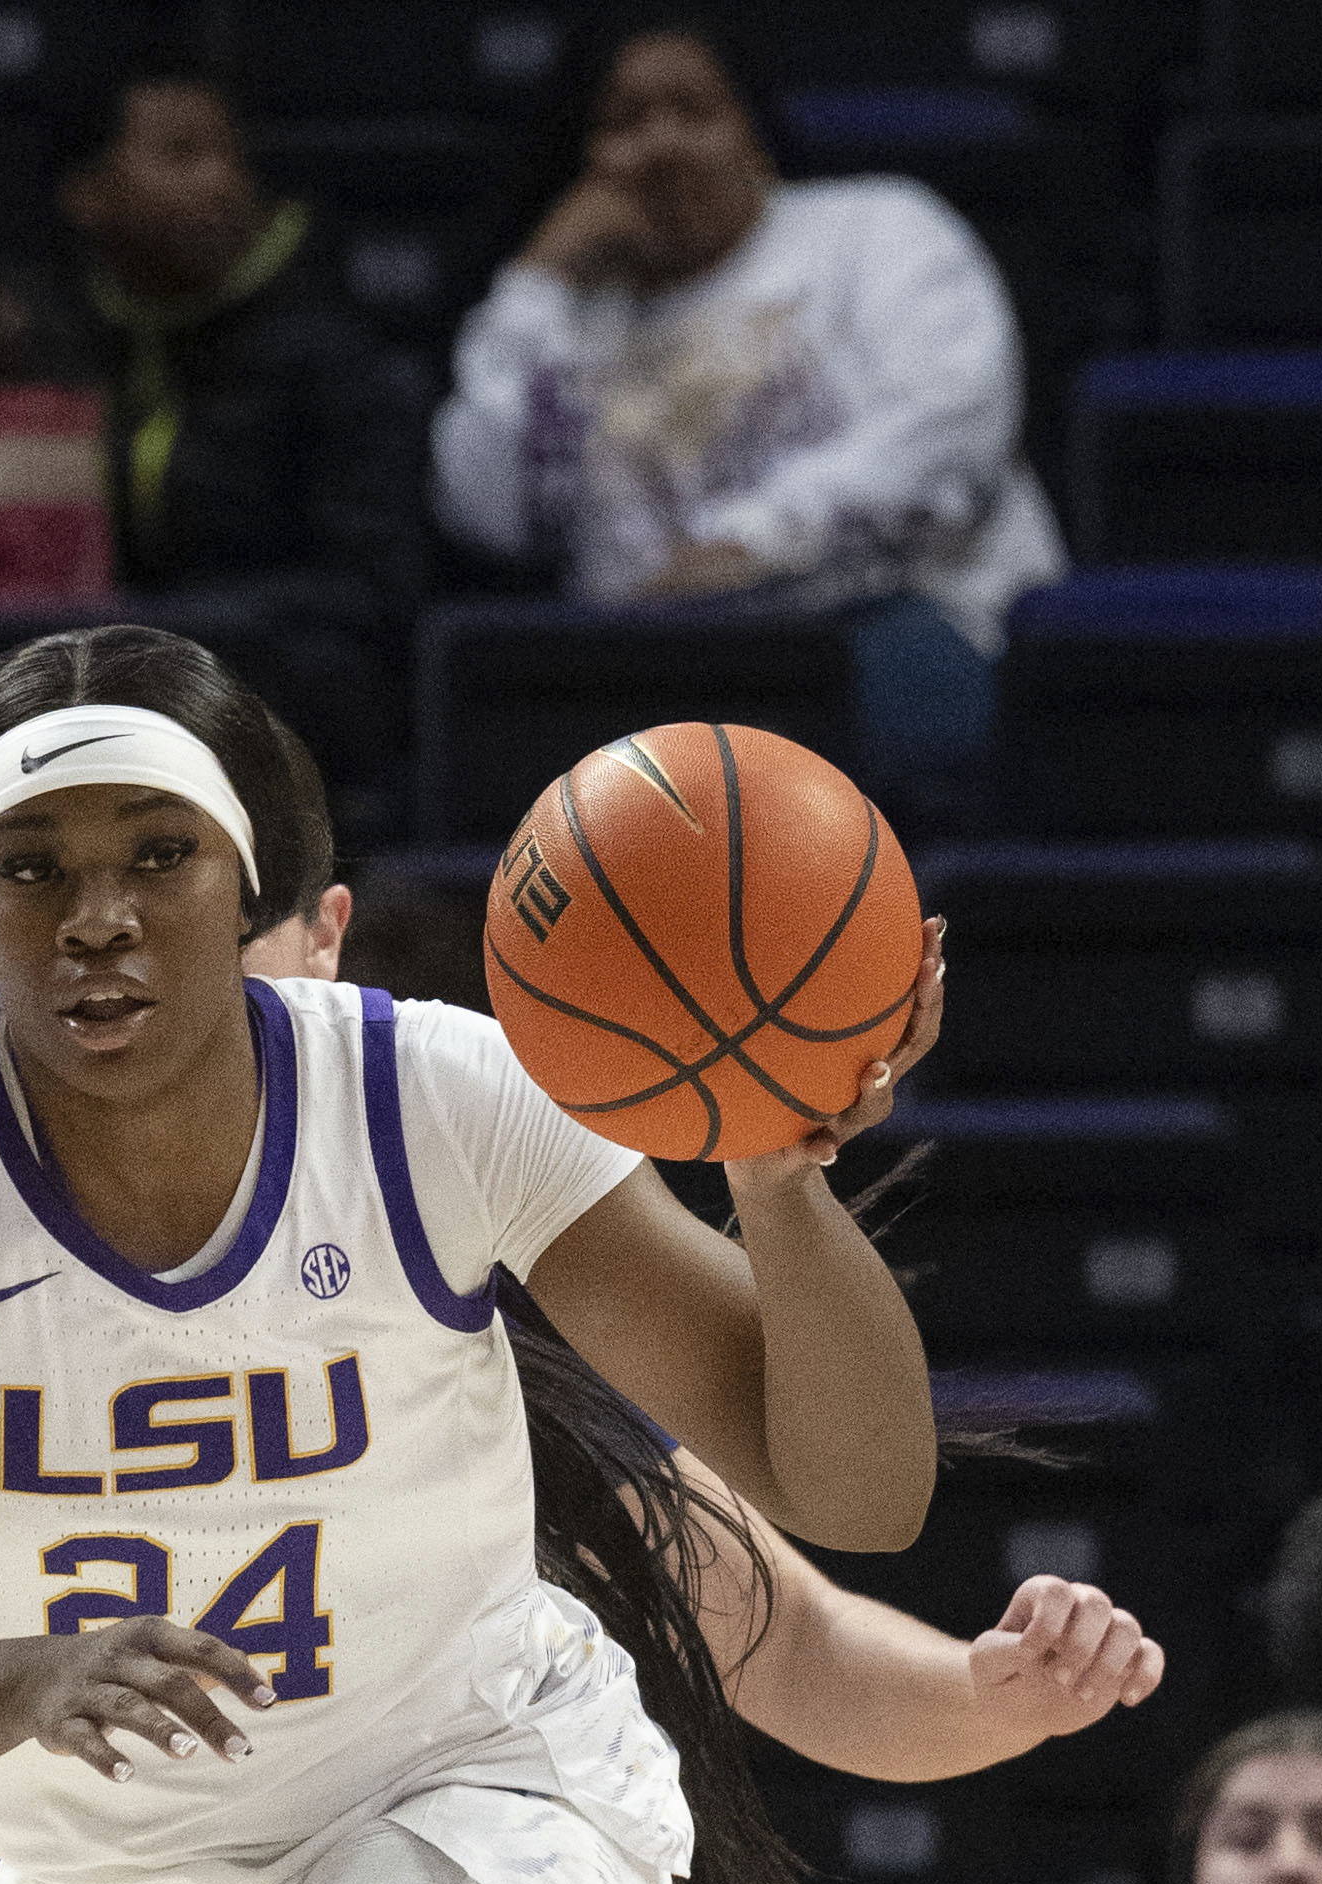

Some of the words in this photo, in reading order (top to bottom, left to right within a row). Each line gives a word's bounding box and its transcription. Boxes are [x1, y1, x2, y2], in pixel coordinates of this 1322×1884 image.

[301, 1244, 350, 1298] SEC
[0, 1350, 372, 1498] LSU
[39, 1518, 334, 1705] 24
